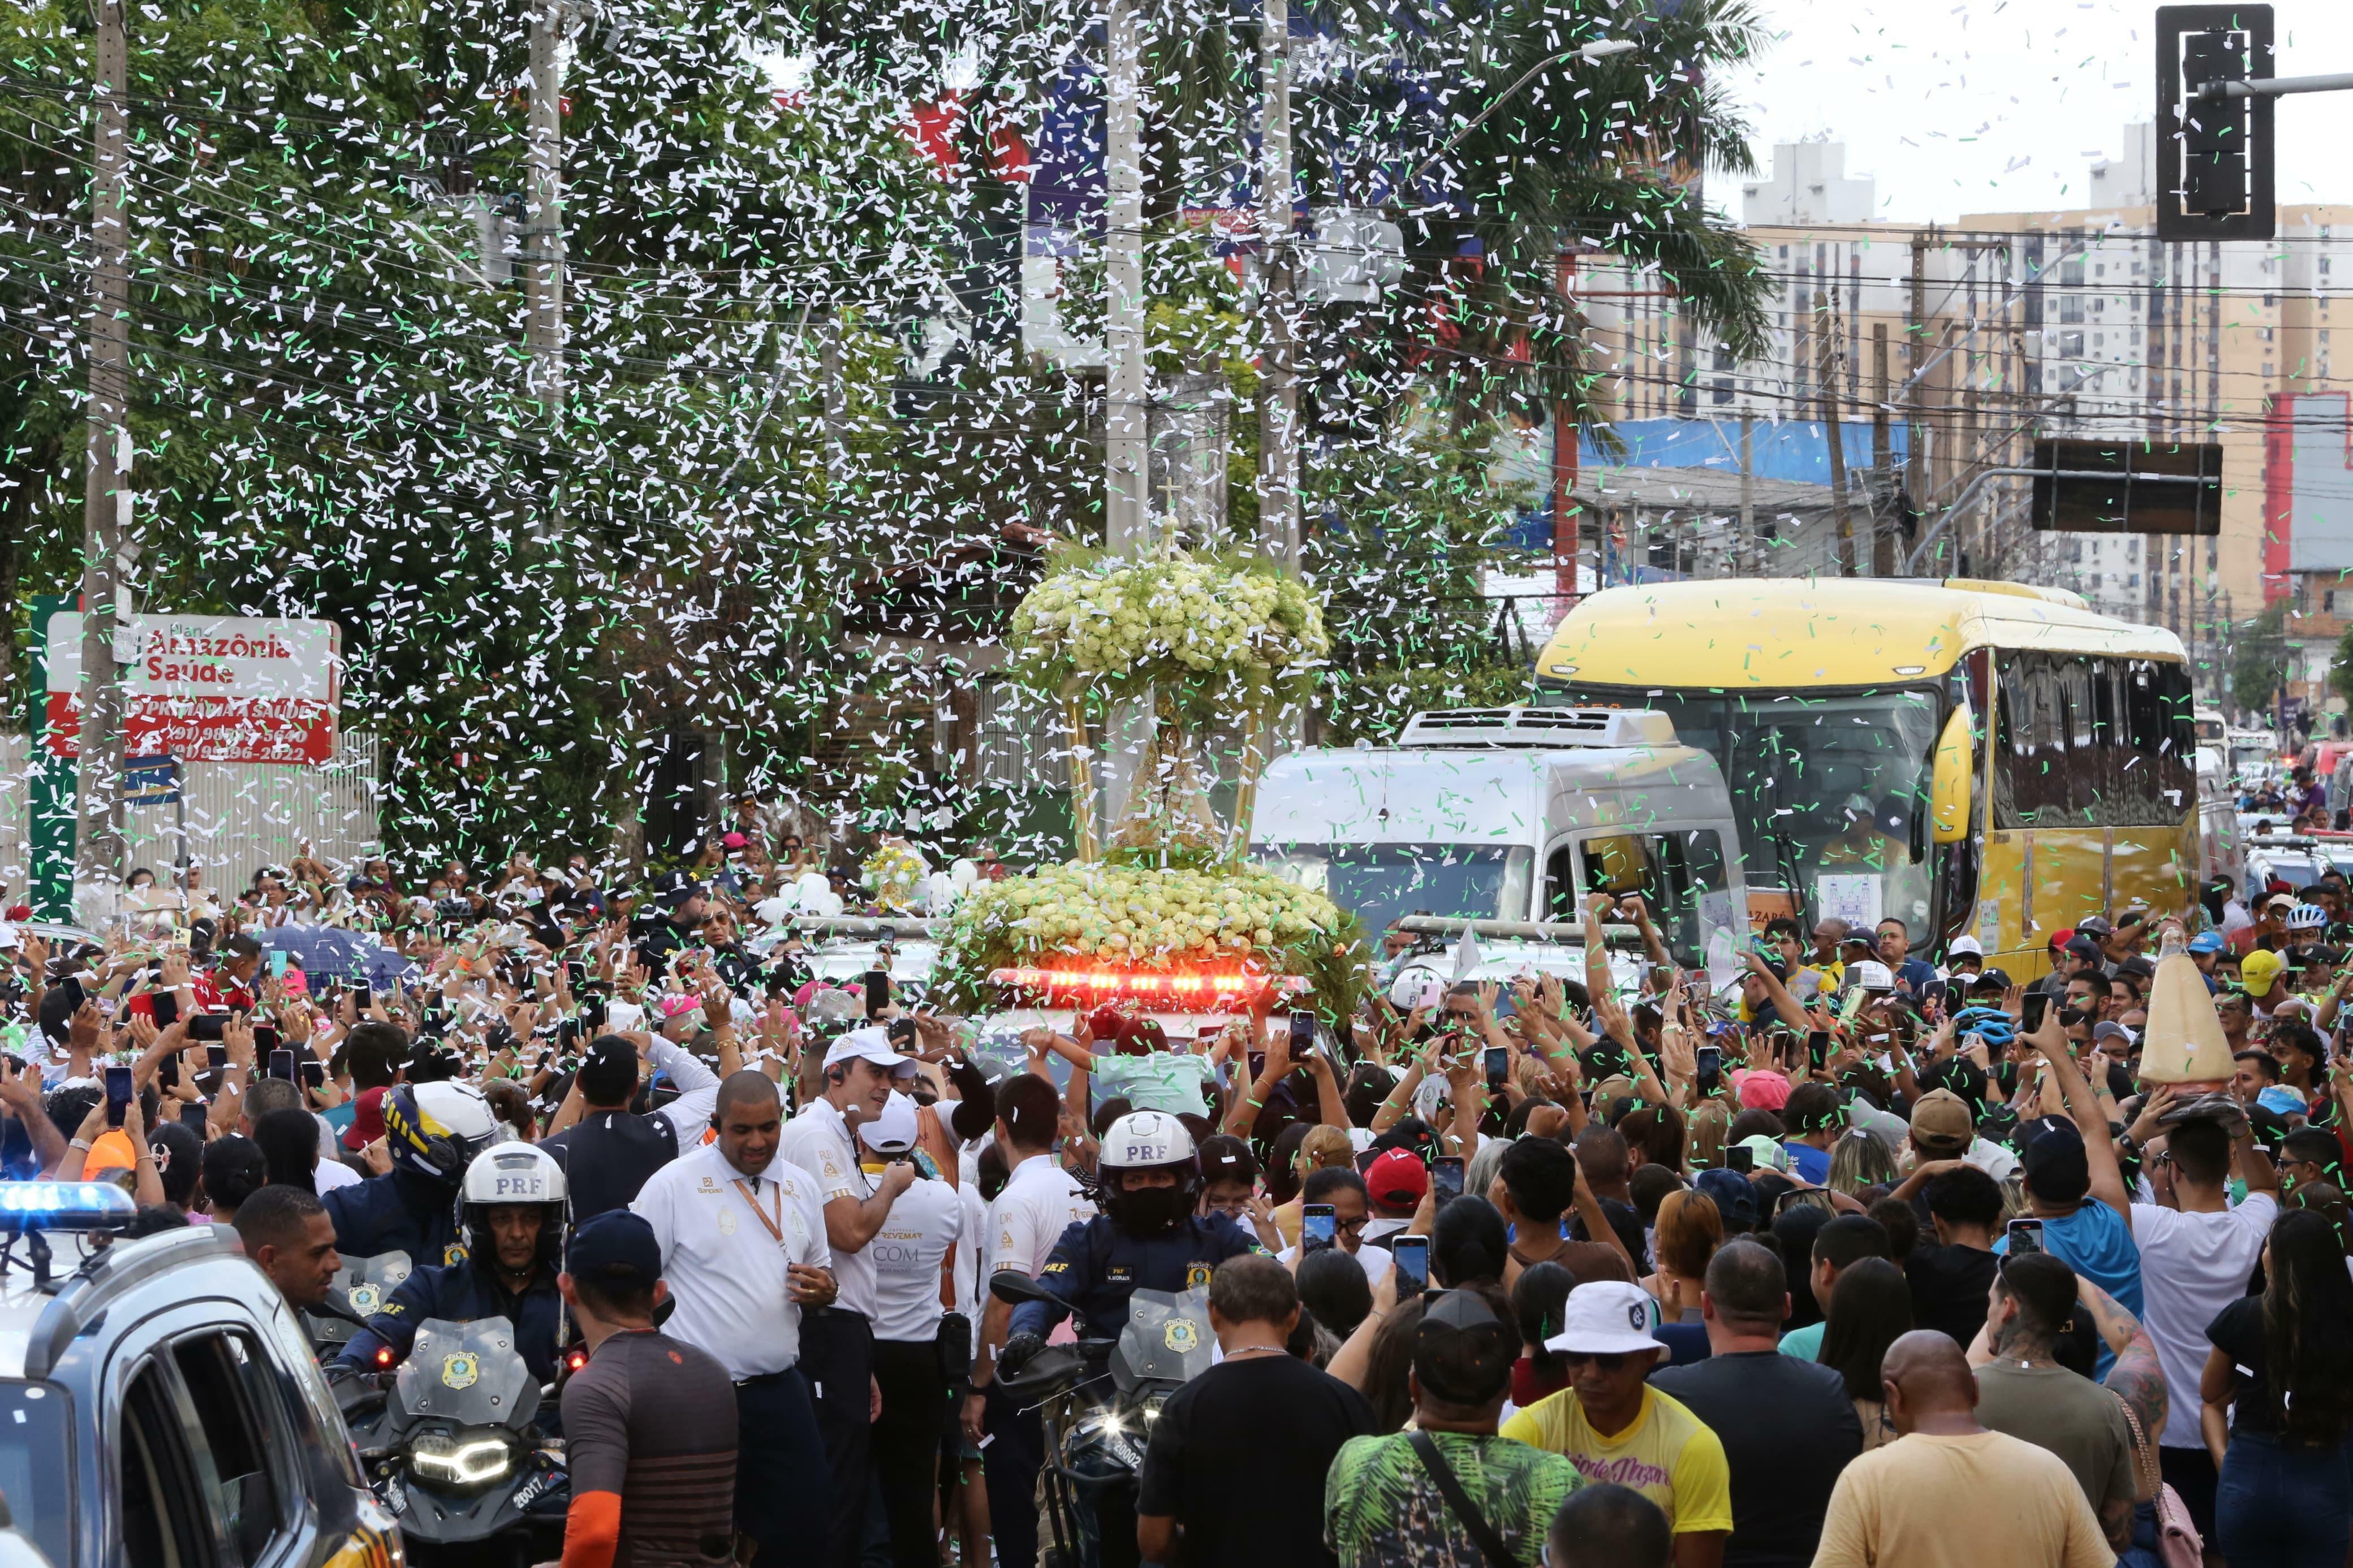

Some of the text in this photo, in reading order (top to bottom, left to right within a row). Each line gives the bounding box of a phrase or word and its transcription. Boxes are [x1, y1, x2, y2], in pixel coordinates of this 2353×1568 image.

[146, 629, 290, 659] Amazônia
[148, 656, 234, 684] Saúde
[1126, 1145, 1167, 1161] PRF
[496, 1178, 541, 1195] PRF
[999, 1213, 1014, 1224] DR
[1041, 1263, 1068, 1274] PRF
[1114, 1441, 1141, 1468] 20002
[513, 1476, 543, 1509] 20017
